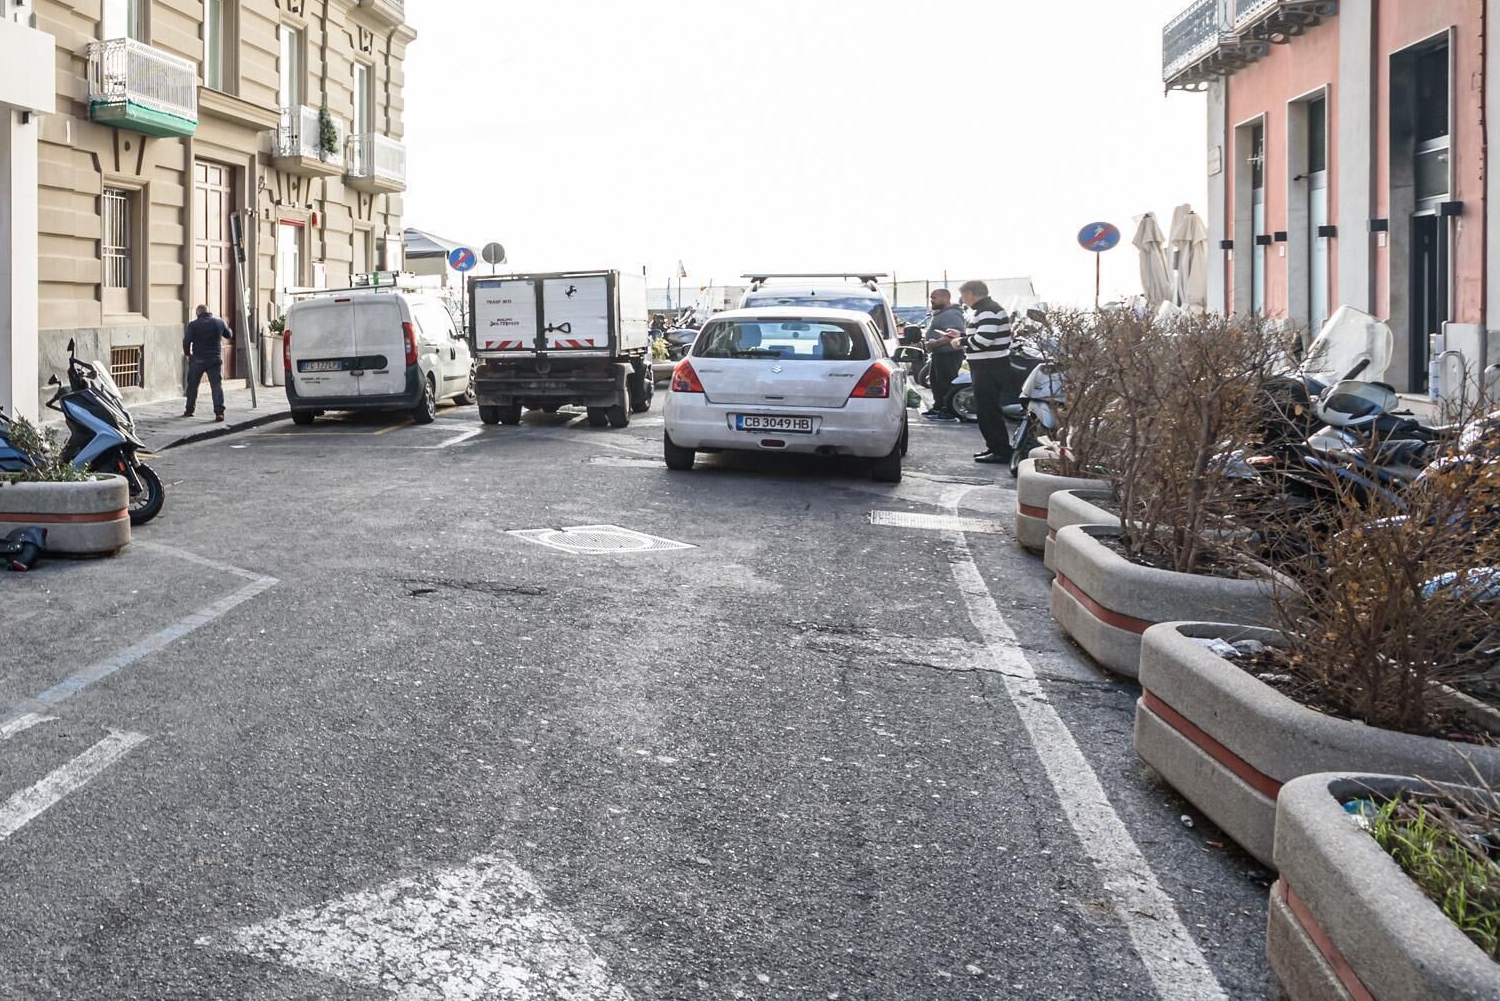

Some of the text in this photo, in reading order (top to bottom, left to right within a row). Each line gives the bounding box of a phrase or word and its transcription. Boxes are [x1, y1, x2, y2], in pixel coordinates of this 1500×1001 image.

[744, 417, 809, 430] CB 3049 HB
